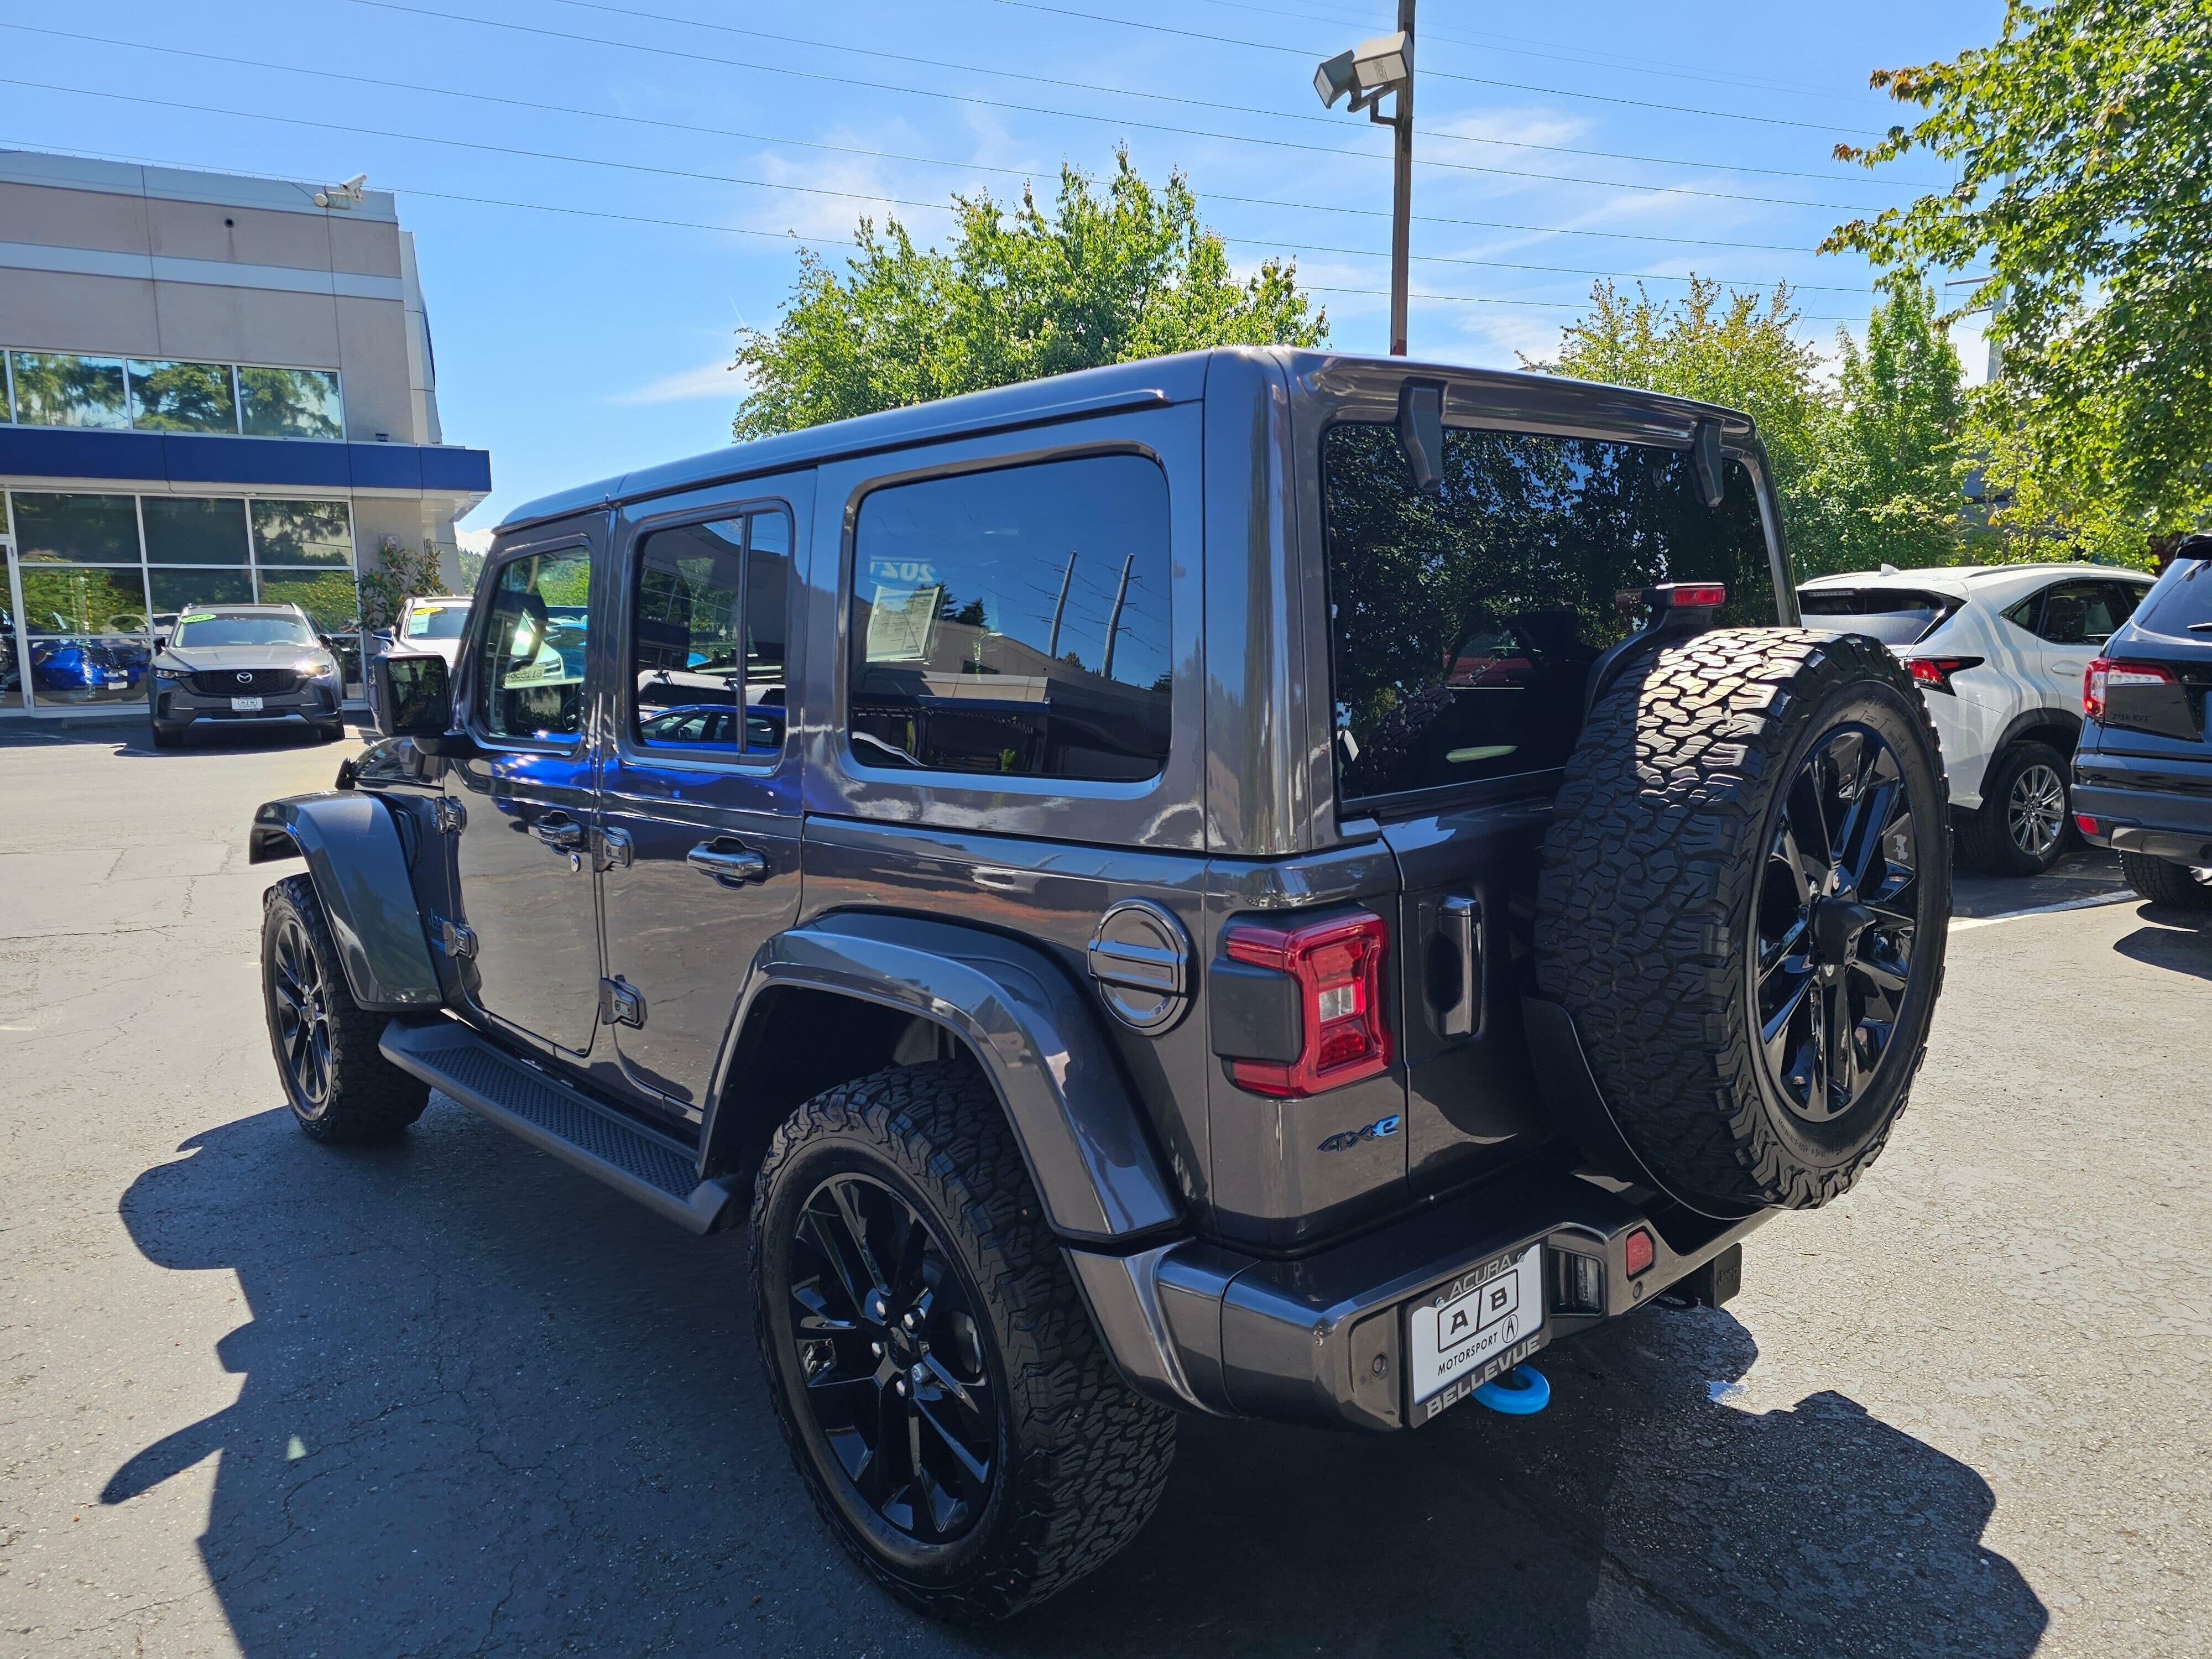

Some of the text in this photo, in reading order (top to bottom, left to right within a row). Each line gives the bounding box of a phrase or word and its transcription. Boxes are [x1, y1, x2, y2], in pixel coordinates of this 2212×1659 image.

[1449, 1254, 1511, 1299] ACURA
[1450, 1287, 1507, 1335] A B
[1426, 1334, 1540, 1420] BELLEVUE
[1438, 1332, 1498, 1376] MOTORSPORT
